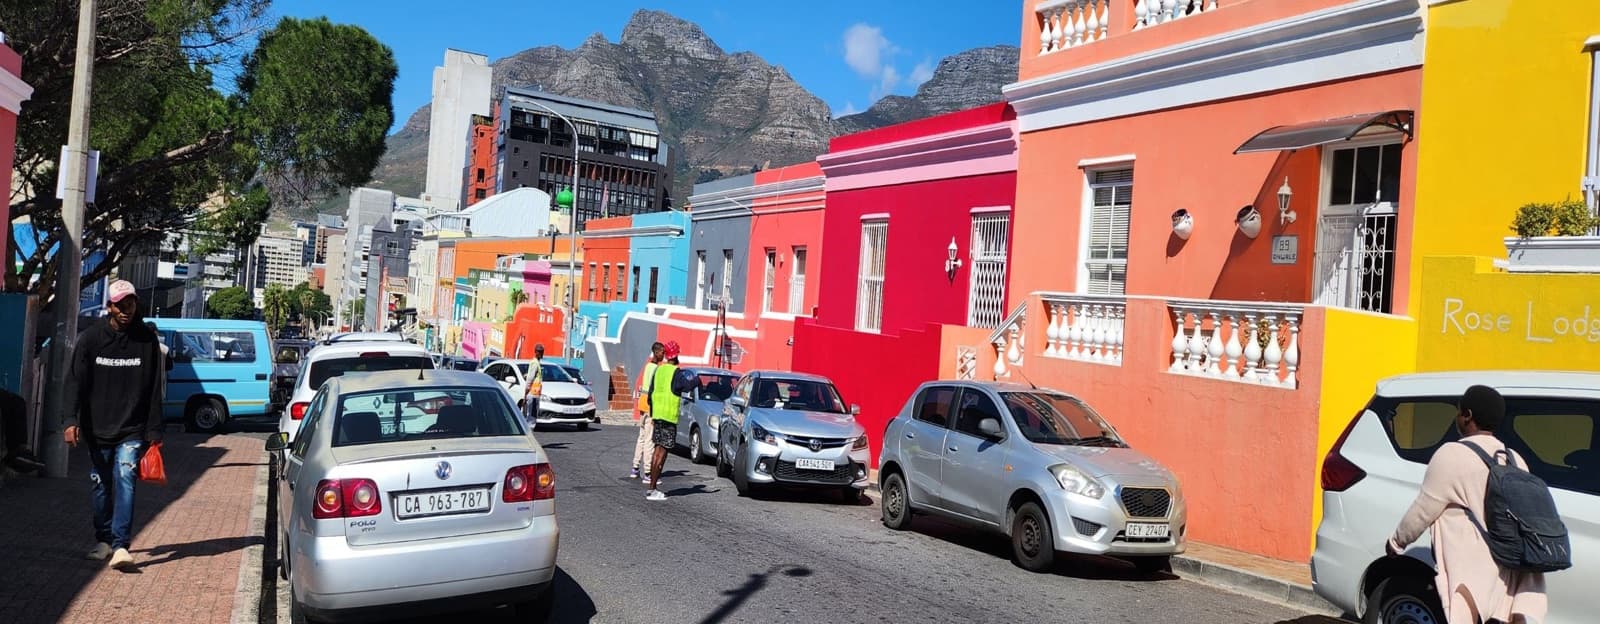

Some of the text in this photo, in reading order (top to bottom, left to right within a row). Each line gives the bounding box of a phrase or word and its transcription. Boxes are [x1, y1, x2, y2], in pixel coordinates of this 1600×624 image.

[1441, 297, 1512, 335] Rose
[405, 491, 483, 513] CA 963-787
[350, 519, 377, 527] POLO
[1128, 524, 1167, 537] CEY 27407
